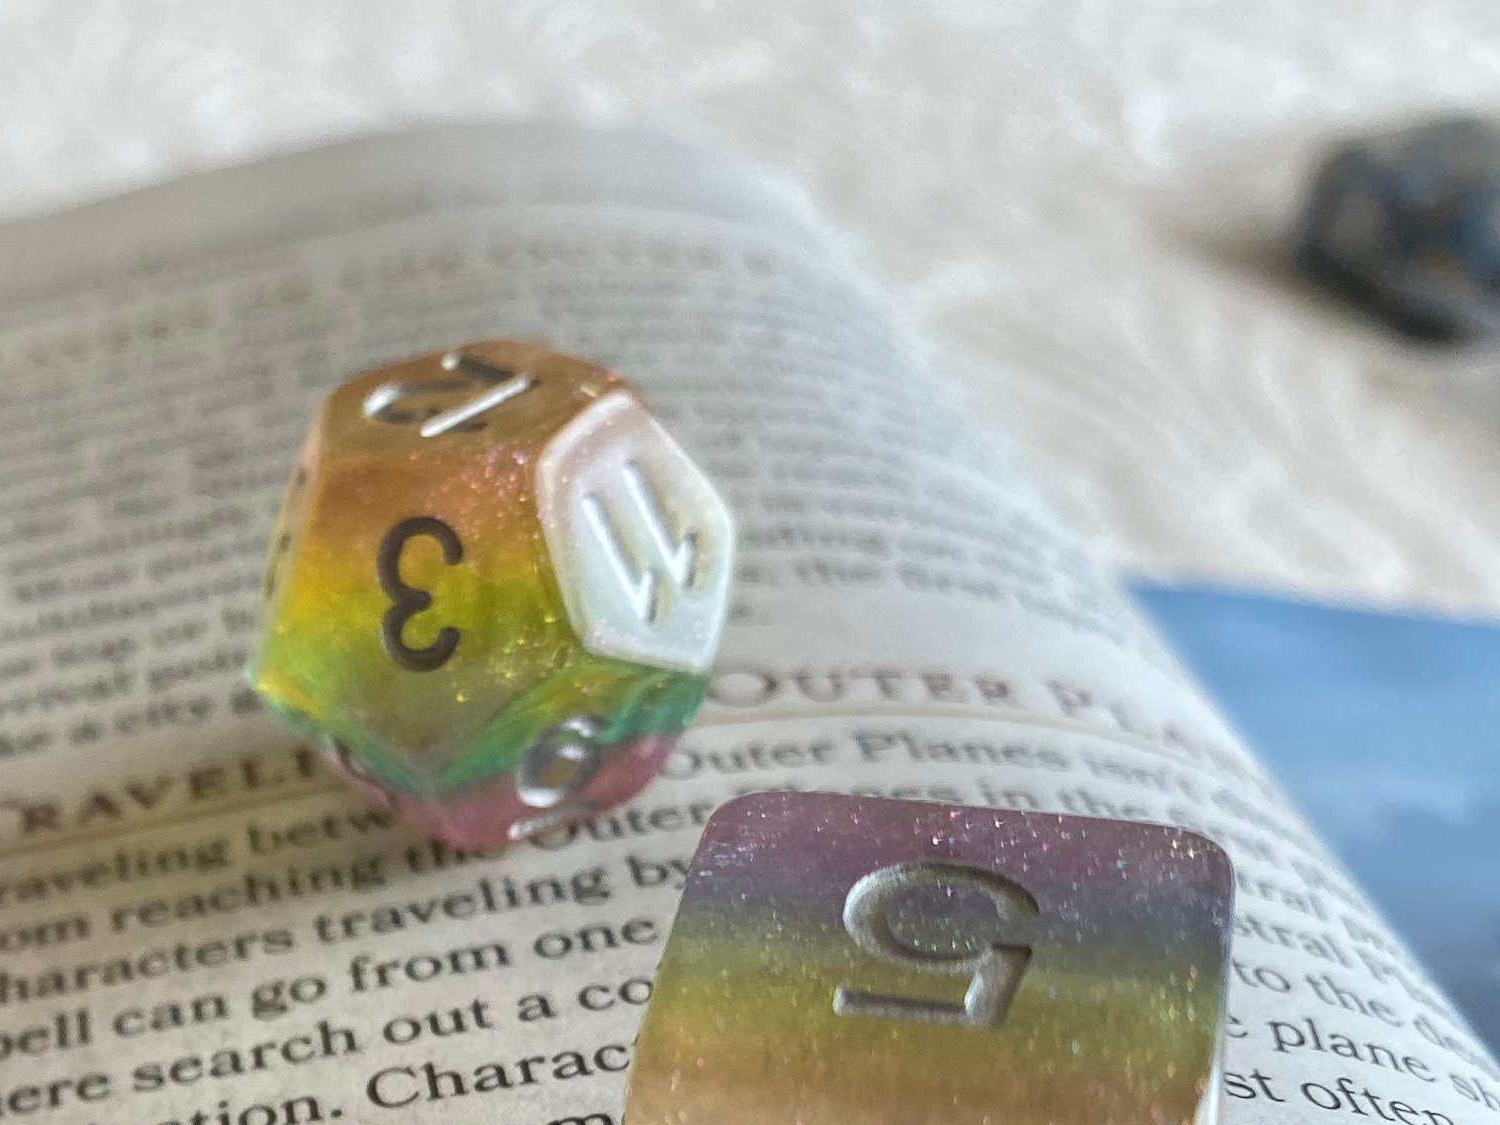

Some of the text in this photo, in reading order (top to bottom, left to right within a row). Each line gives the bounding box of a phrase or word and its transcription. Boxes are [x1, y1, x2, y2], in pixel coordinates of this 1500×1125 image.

[376, 516, 463, 672] 3
[657, 740, 834, 780] Outer
[852, 728, 1074, 773] Planes
[247, 803, 396, 853] betw
[111, 856, 387, 933] reaching
[405, 838, 498, 874] th
[314, 865, 611, 943] traveling
[112, 993, 229, 1038] can
[252, 975, 328, 1020] go
[350, 942, 512, 993] from
[533, 916, 660, 959] one
[1305, 972, 1405, 1029] the
[812, 858, 1040, 1030] 5
[132, 1020, 363, 1093] search
[382, 998, 494, 1045] out
[516, 991, 557, 1023] a
[576, 976, 654, 1012] co
[1267, 1015, 1438, 1083] plane
[366, 1043, 631, 1109] Charac
[1222, 1068, 1287, 1103] st
